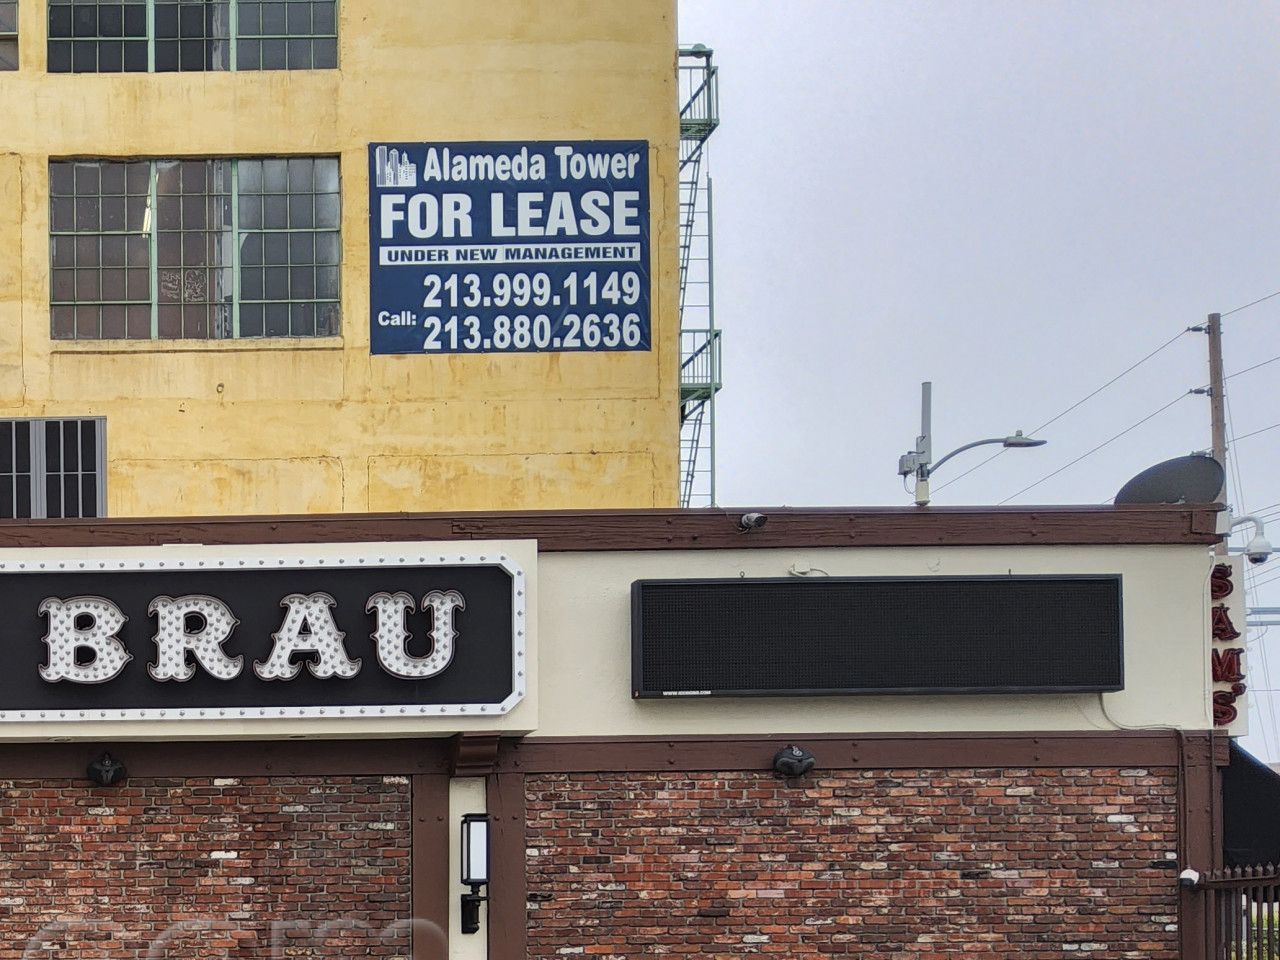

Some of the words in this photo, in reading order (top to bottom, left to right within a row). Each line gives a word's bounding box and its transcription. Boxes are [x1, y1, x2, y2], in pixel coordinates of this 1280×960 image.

[423, 147, 546, 182] Alameda
[554, 146, 640, 180] Tower
[380, 192, 472, 238] FOR
[491, 191, 640, 238] LEASE
[387, 248, 449, 262] UNDER
[455, 247, 498, 261] NEW
[505, 245, 636, 260] MANAGEMENT
[423, 271, 641, 308] 213.999.1149
[378, 310, 417, 326] Call:
[423, 313, 641, 350] 213.880.2636
[38, 589, 466, 683] BRAU
